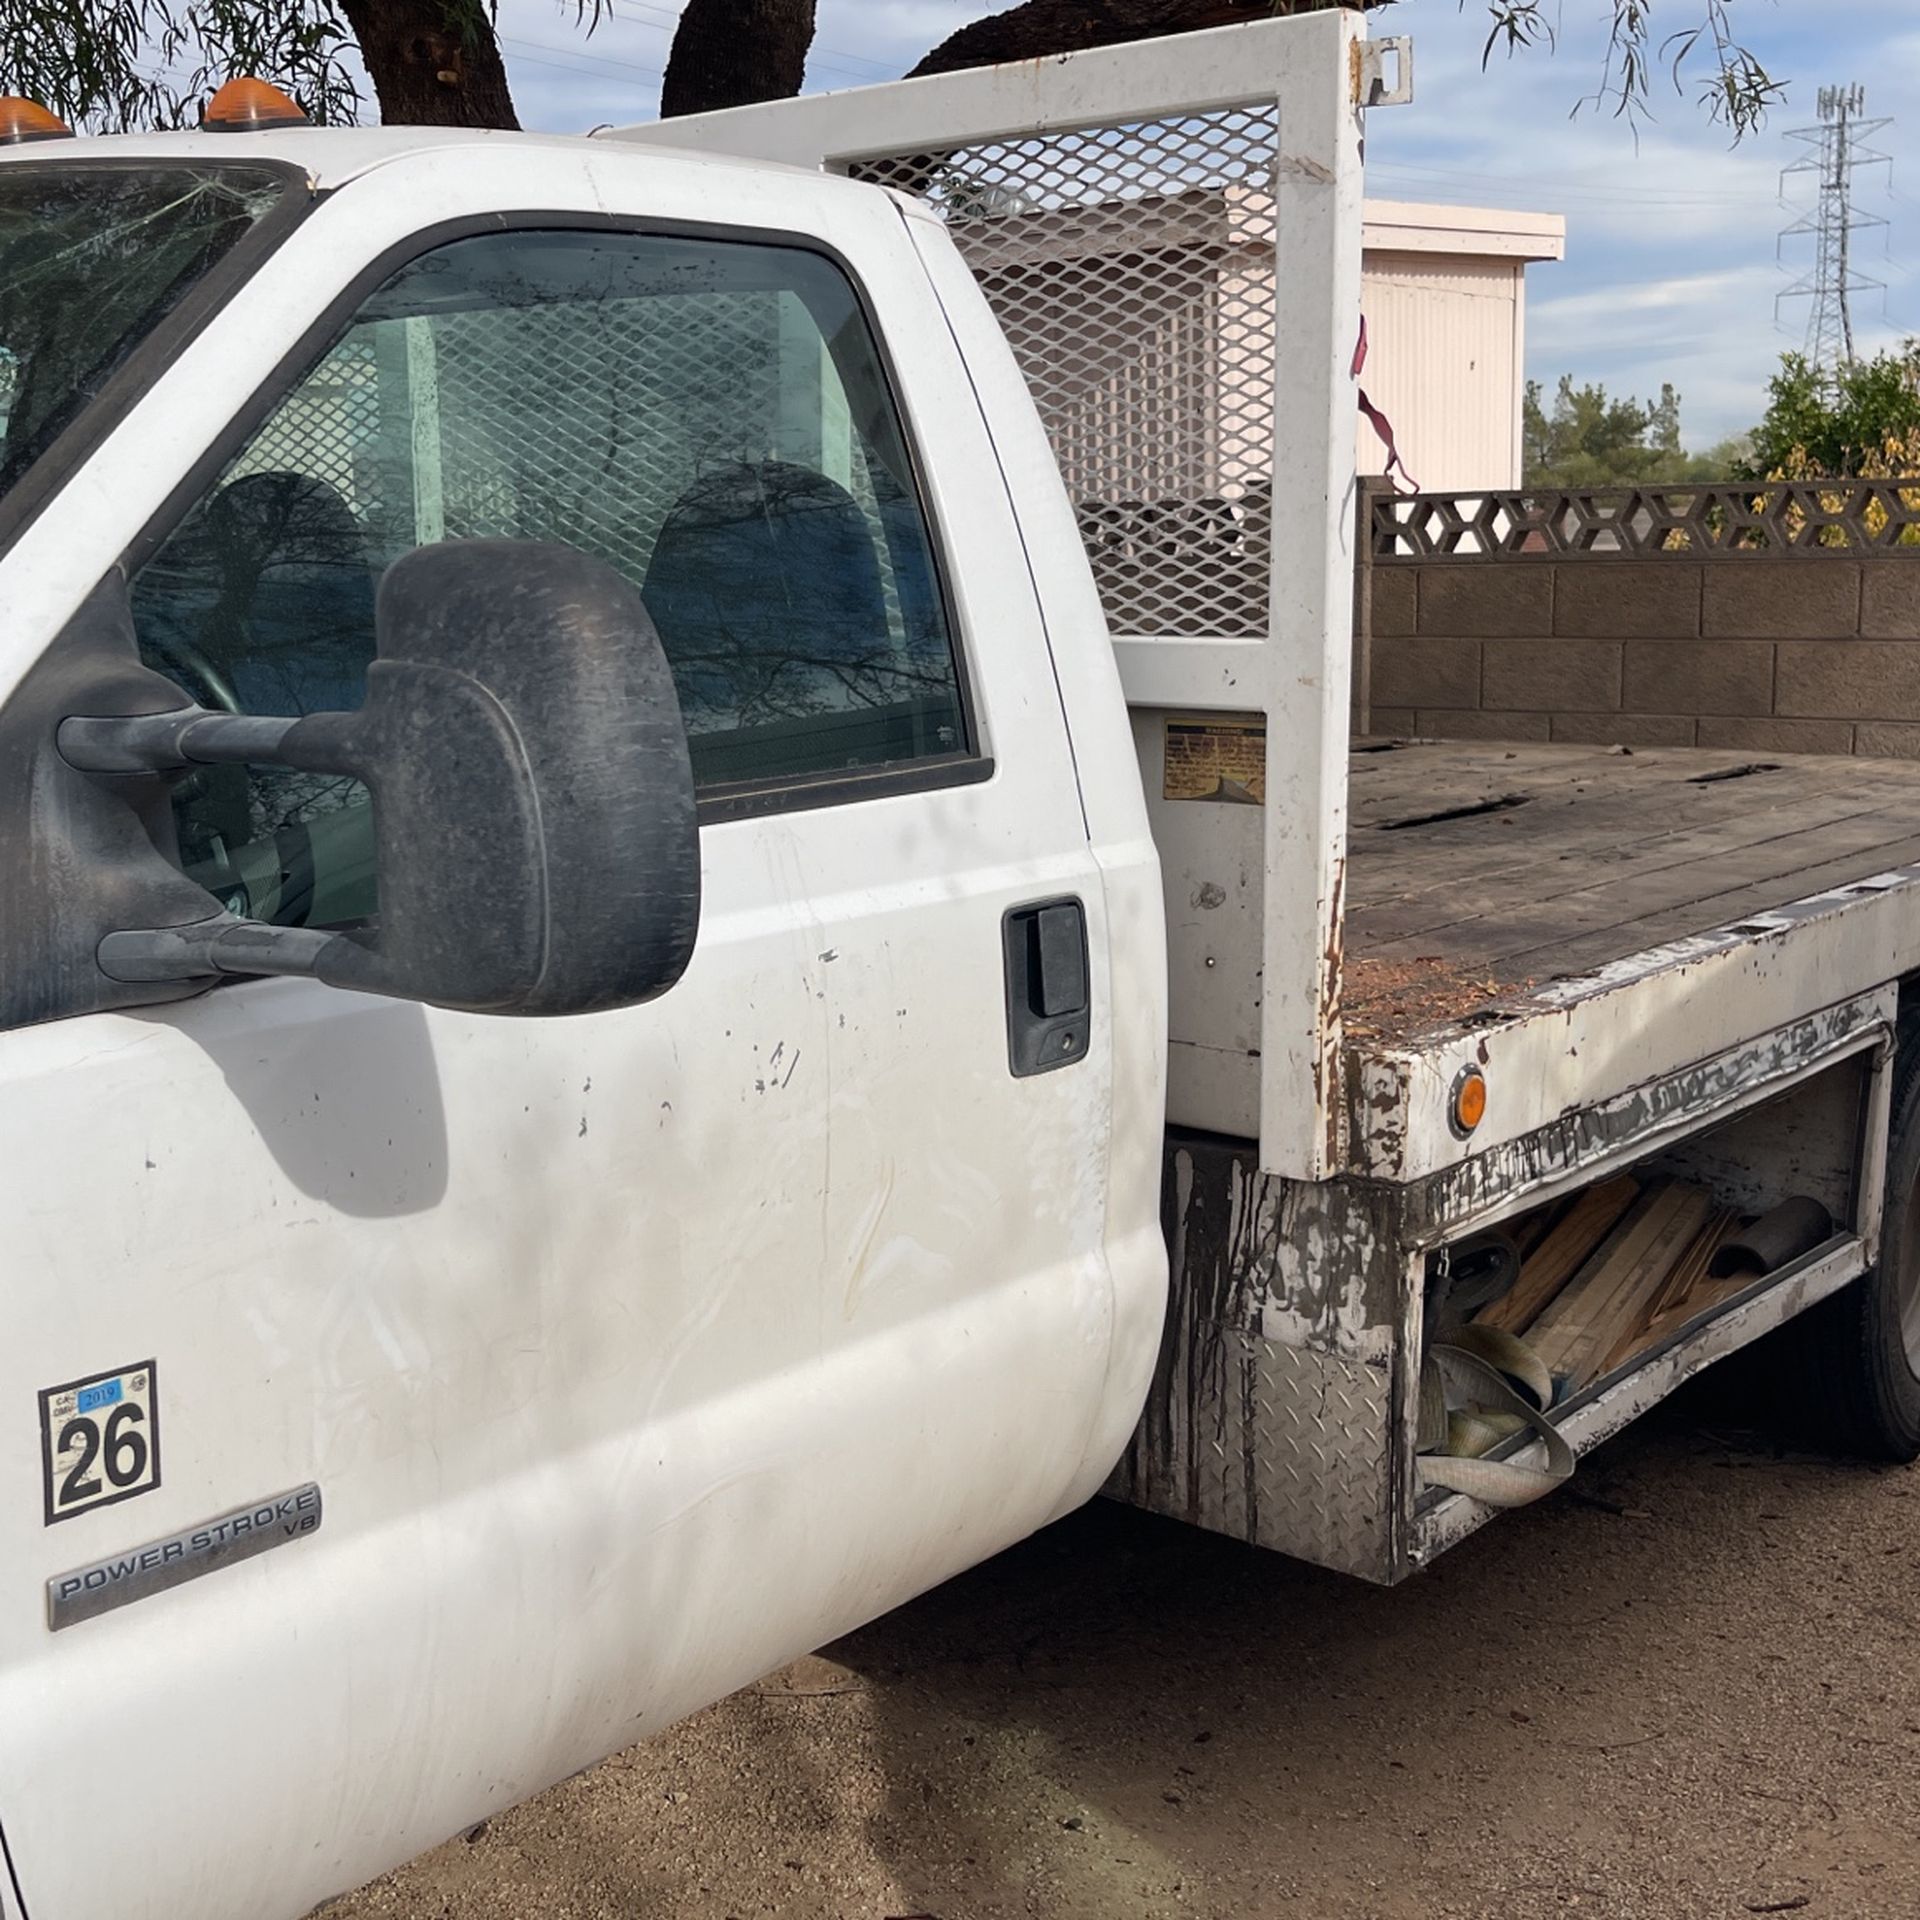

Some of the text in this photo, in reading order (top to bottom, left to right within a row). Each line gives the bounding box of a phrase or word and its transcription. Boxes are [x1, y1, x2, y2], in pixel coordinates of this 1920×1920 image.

[85, 1386, 115, 1407] 2019
[57, 1402, 147, 1506] 26
[59, 1490, 316, 1599] POWER STROKE
[283, 1514, 316, 1535] V8
